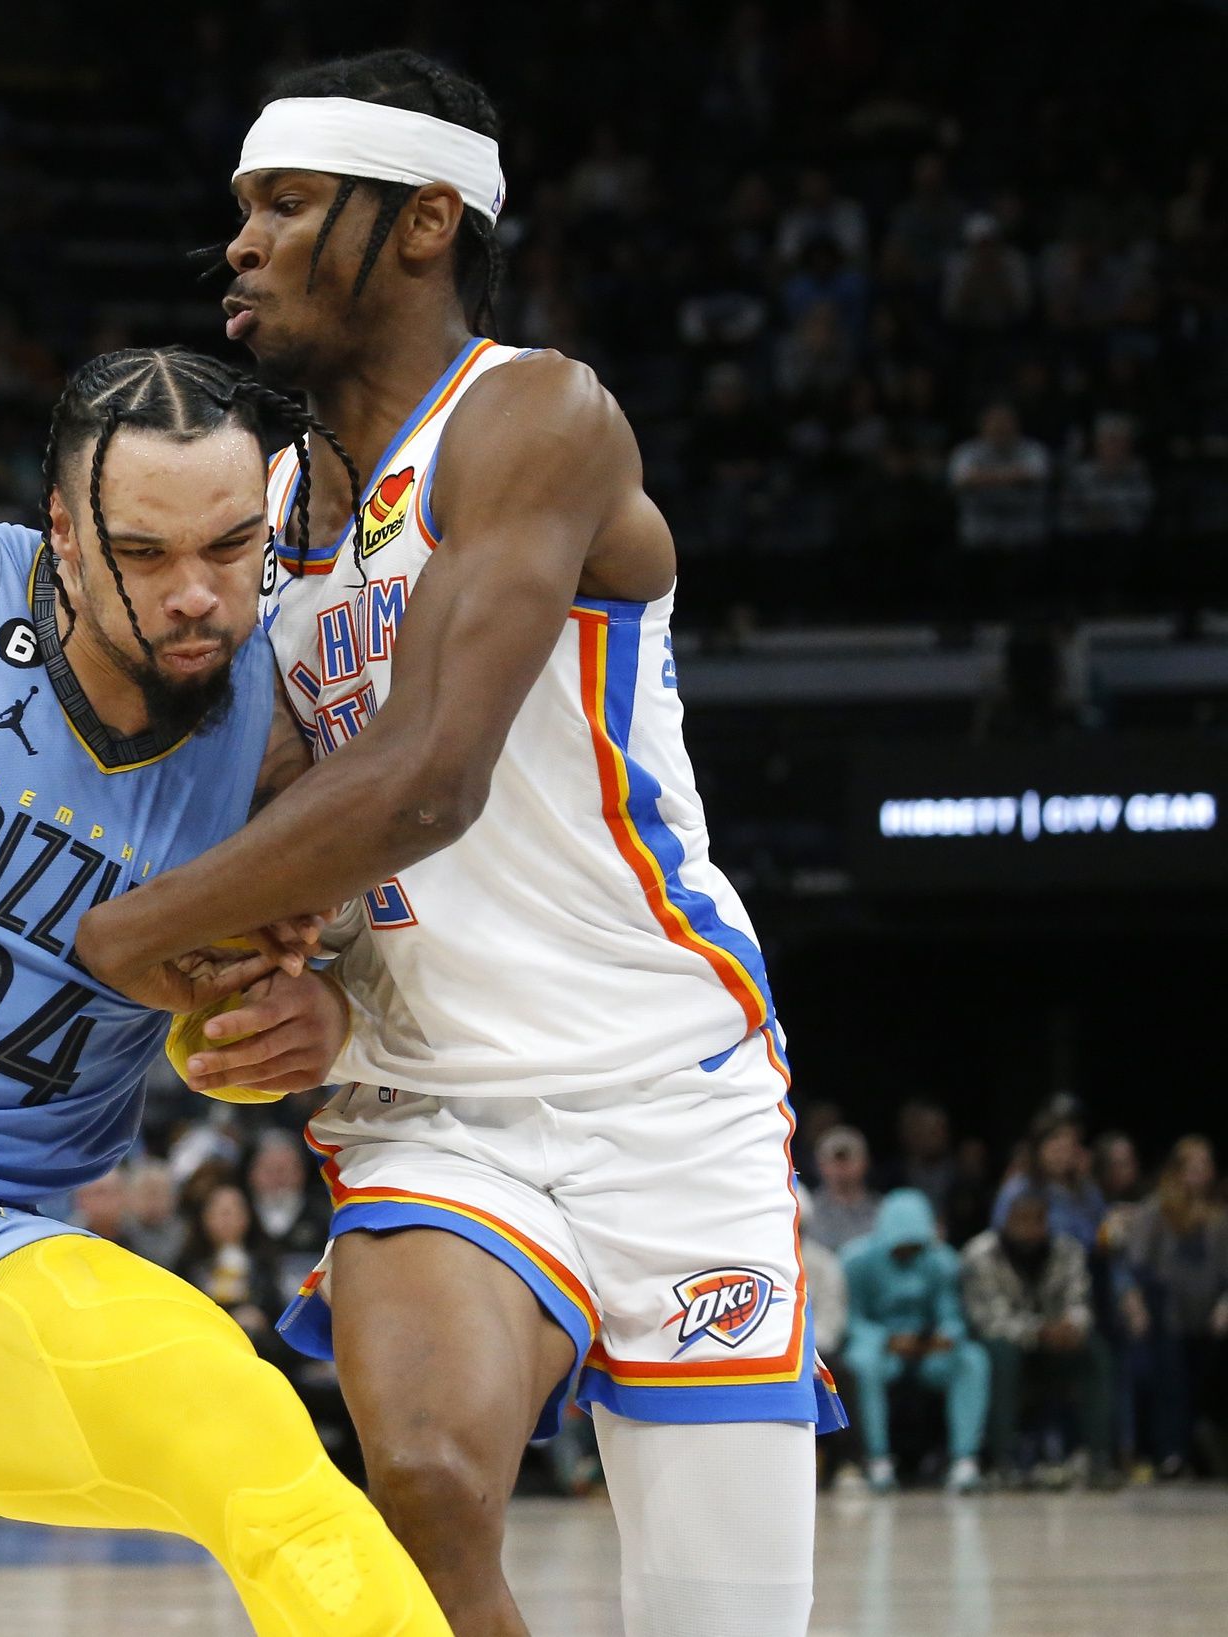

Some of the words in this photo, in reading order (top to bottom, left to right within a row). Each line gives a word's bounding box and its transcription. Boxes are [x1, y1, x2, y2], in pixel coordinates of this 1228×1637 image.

[5, 624, 37, 663] 6
[1042, 795, 1122, 833] CITY
[1125, 792, 1216, 832] GEAR
[681, 1280, 754, 1341] OKC
